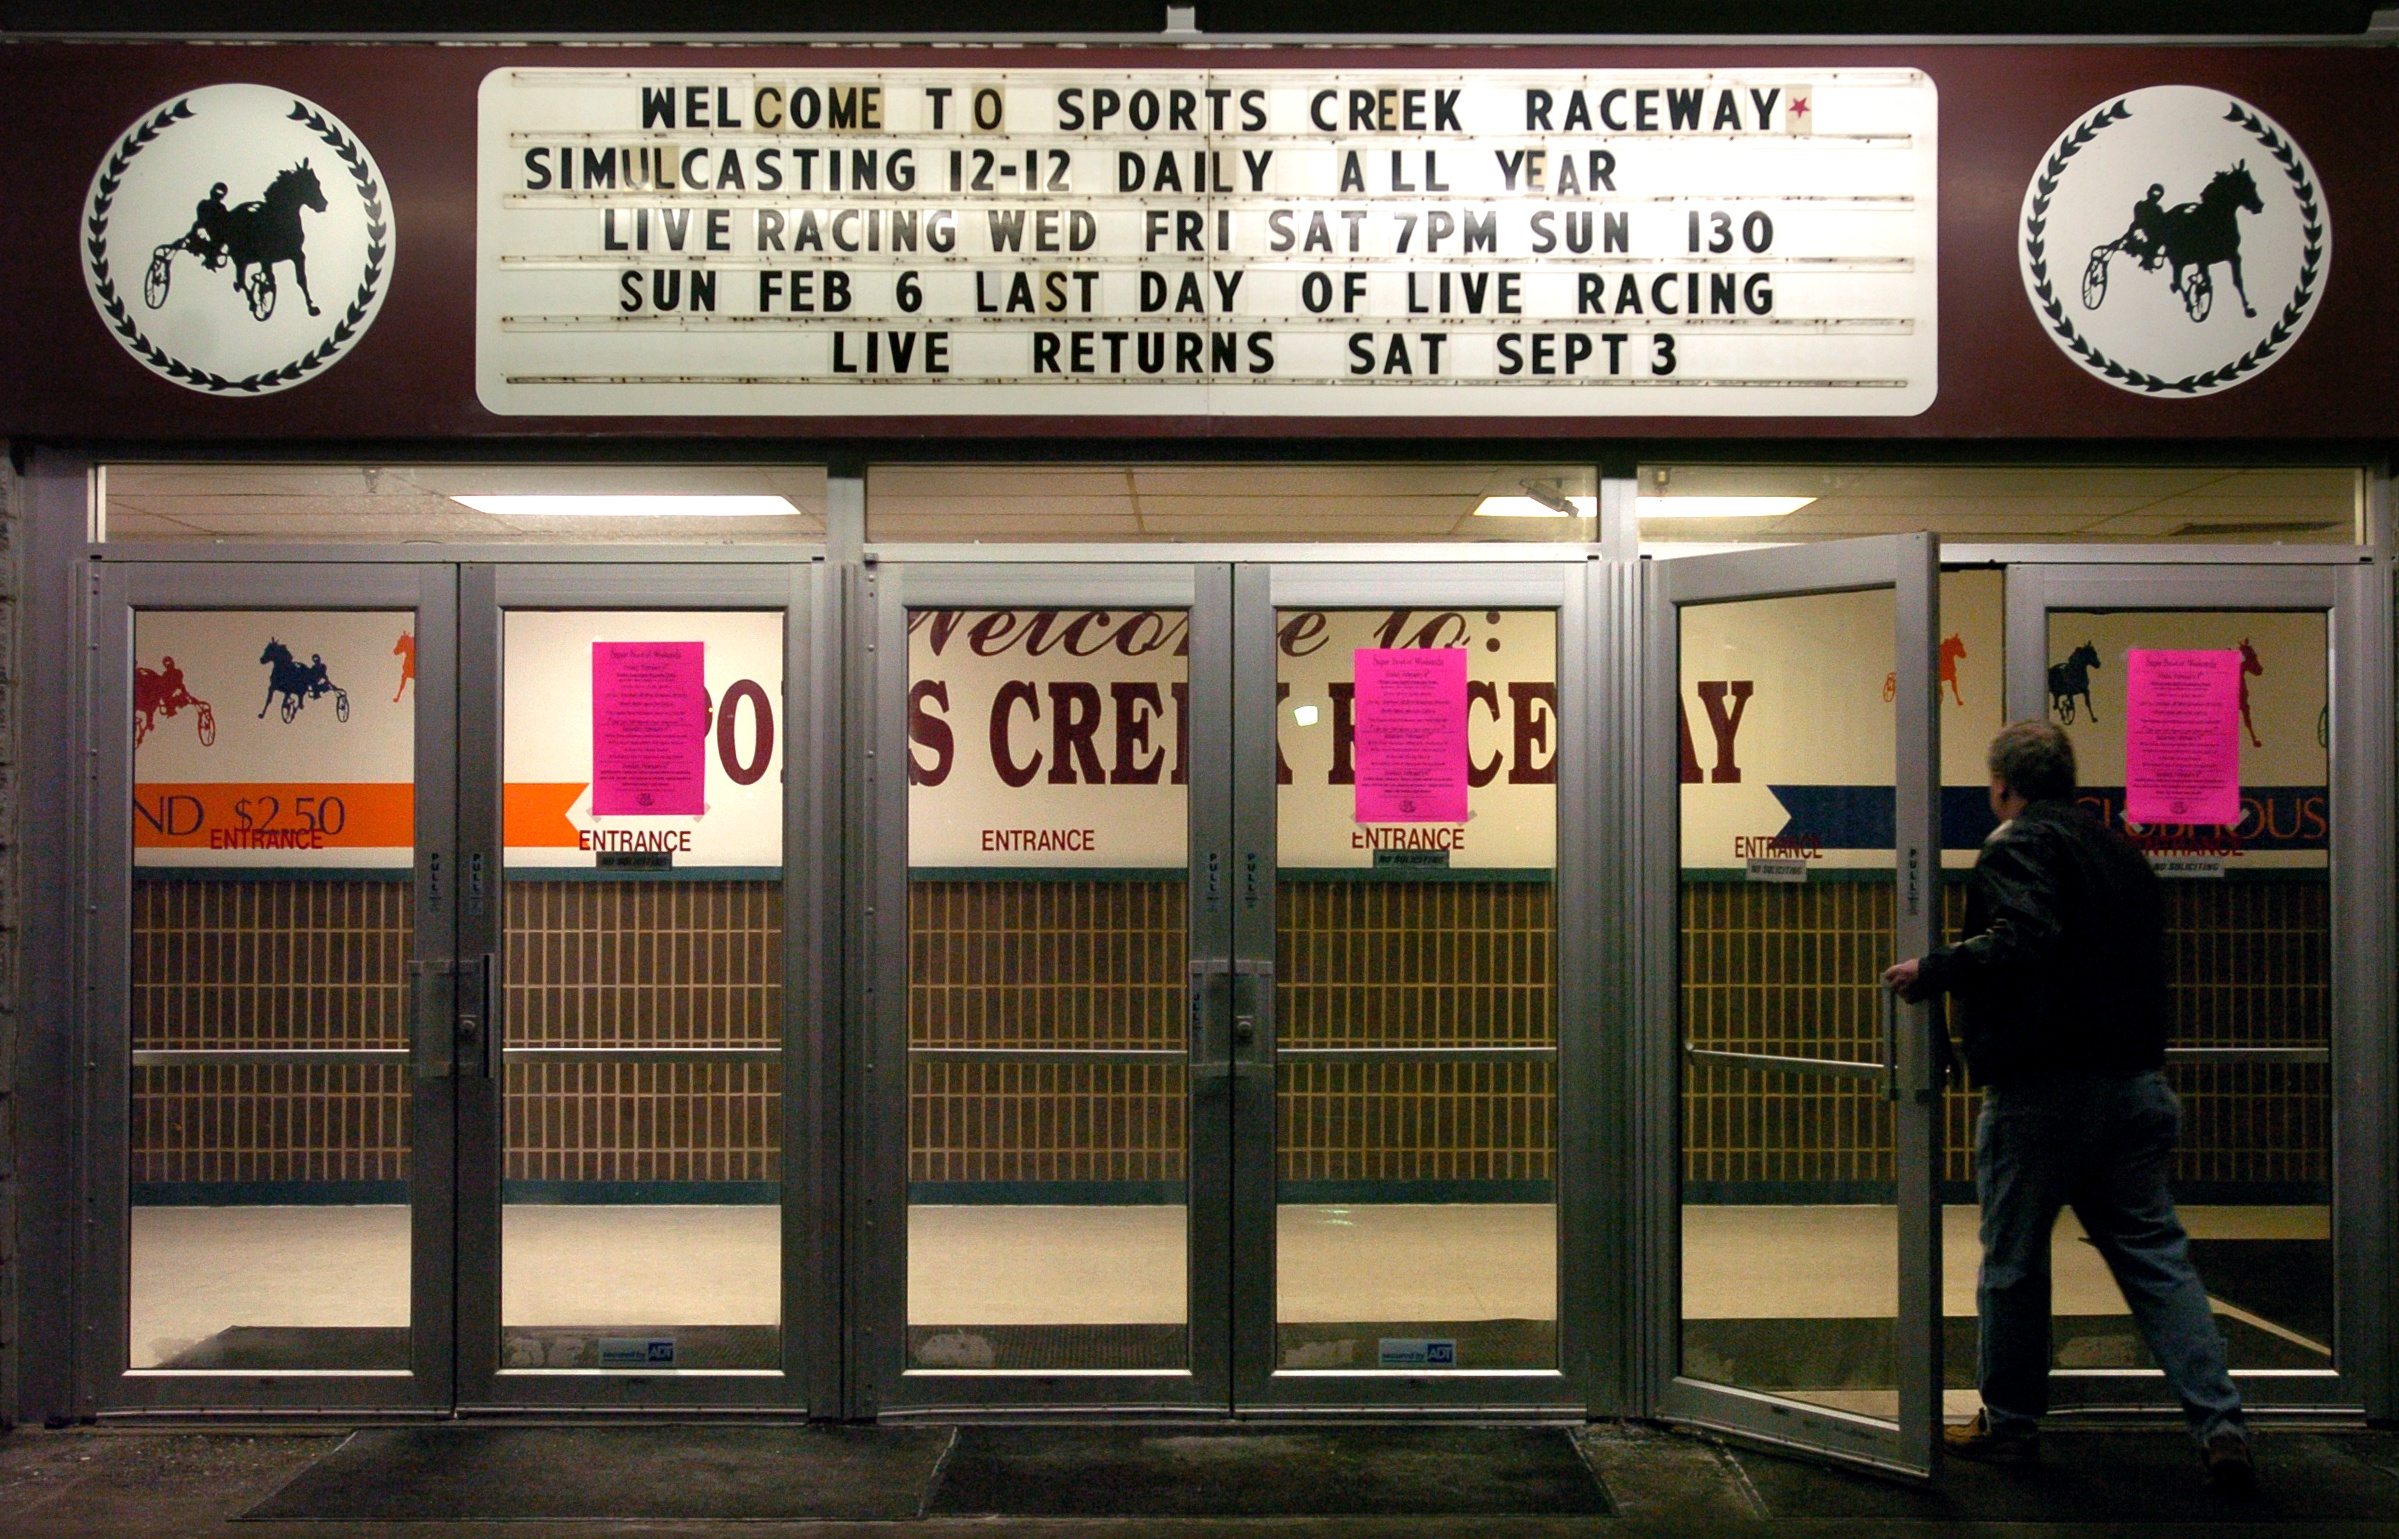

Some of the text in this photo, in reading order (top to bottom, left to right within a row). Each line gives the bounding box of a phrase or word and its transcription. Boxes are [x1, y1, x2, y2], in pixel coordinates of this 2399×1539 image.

[642, 86, 1780, 131] WELCOME TO SPORTS CREEK RACEWAY
[524, 147, 1617, 192] SIMULCASTING 12-12 DAILY ALL YEAR
[603, 209, 1774, 253] LIVE RACING WED FRI SAT 7PM SUN 130
[620, 270, 1773, 315] SUN FEB 6 LAST DAY OF LIVE RACING
[832, 331, 1677, 375] LIVE RETURNS SAT SEPT 3
[235, 796, 345, 836] $2.50
[209, 828, 324, 850] ENTRANCE
[578, 829, 692, 852] ENTRANCE
[981, 829, 1095, 851] ENTRANCE
[1351, 827, 1465, 850] ENTRANCE
[1734, 836, 1823, 859] ENTRANCE
[2132, 836, 2244, 856] NTRANCE
[2168, 862, 2220, 872] SOLICITING
[648, 1342, 673, 1361] ADT
[1427, 1345, 1452, 1362] ADT
